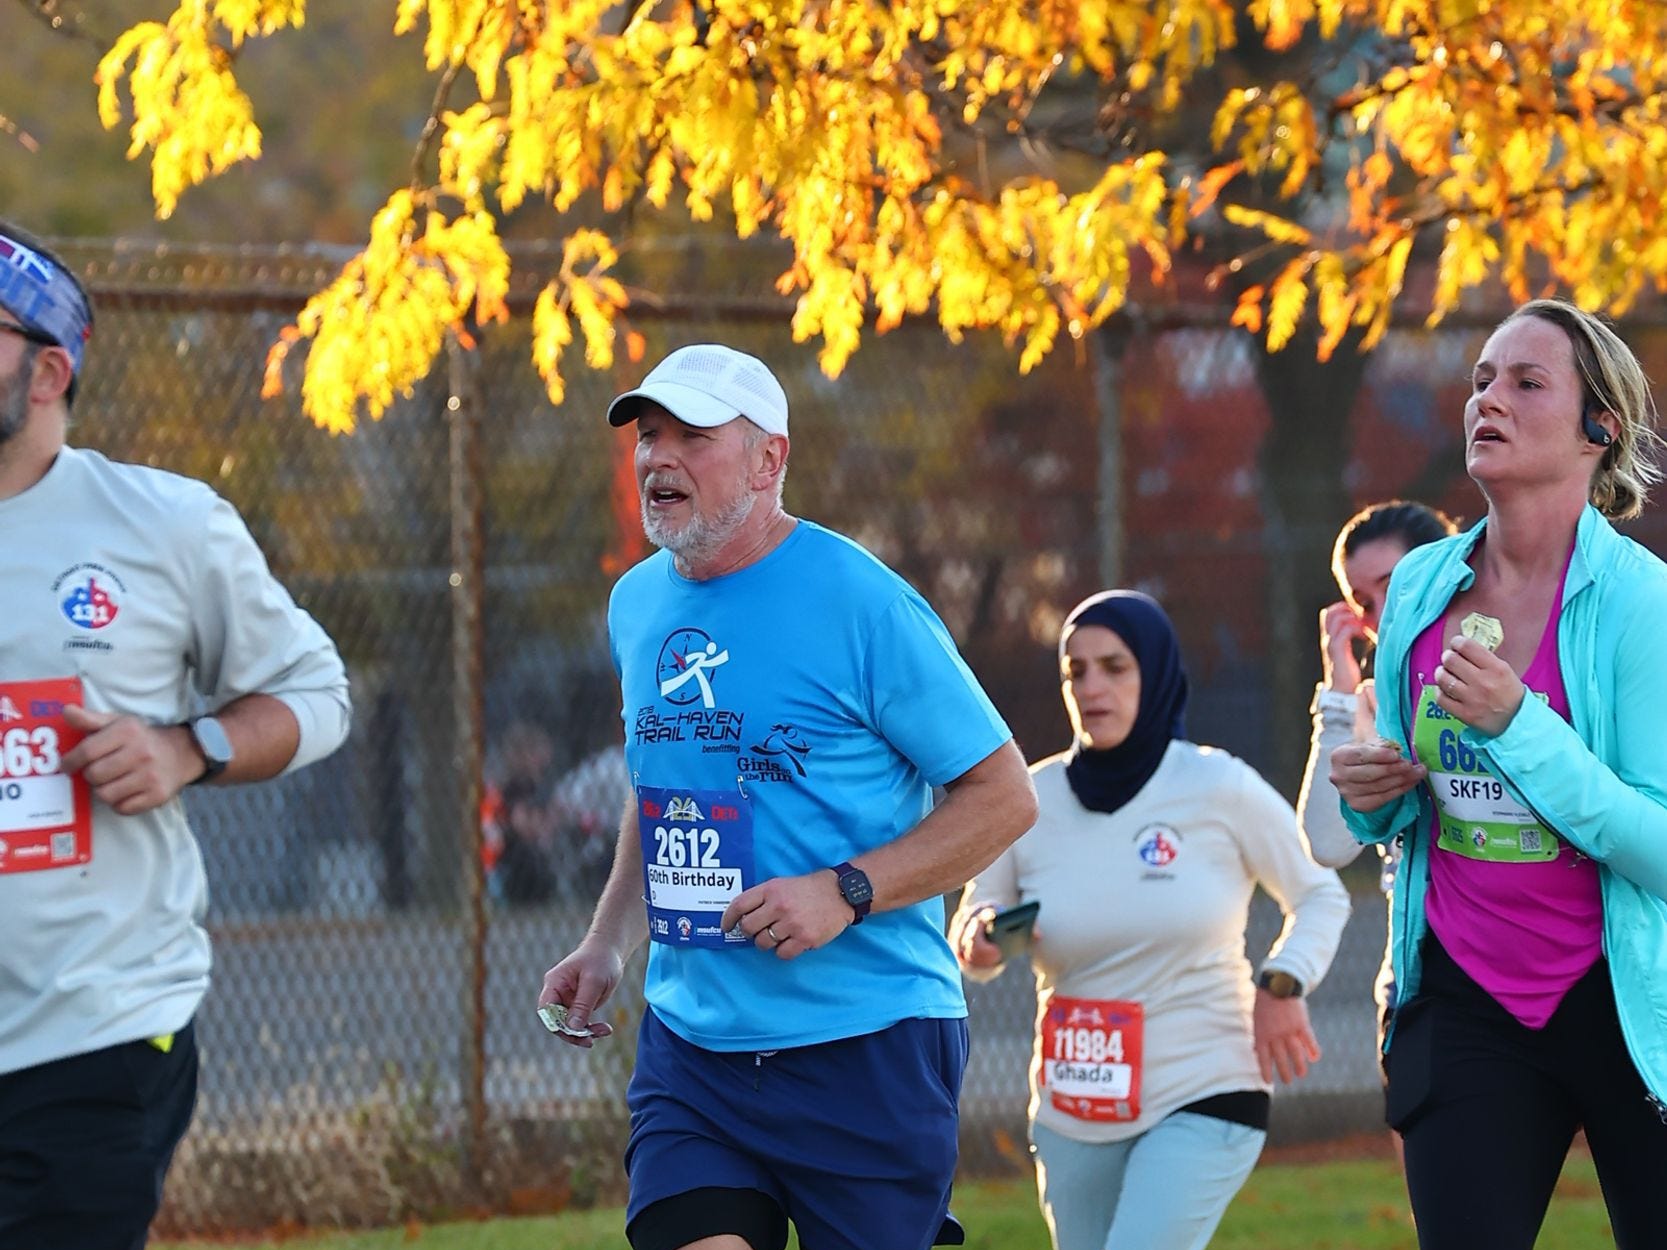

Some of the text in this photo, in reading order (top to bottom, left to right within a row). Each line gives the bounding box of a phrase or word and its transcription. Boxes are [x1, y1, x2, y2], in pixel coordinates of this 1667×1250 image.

[635, 725, 742, 745] TRAIL RUN
[0, 726, 60, 777] 63
[1440, 729, 1490, 773] 66
[737, 757, 780, 771] Girls
[759, 771, 793, 783] run
[1451, 779, 1503, 800] SKF19
[654, 826, 721, 867] 2612
[649, 868, 735, 890] 60th Birthday
[1054, 1027, 1124, 1063] 11984
[1053, 1061, 1114, 1083] Ghada
